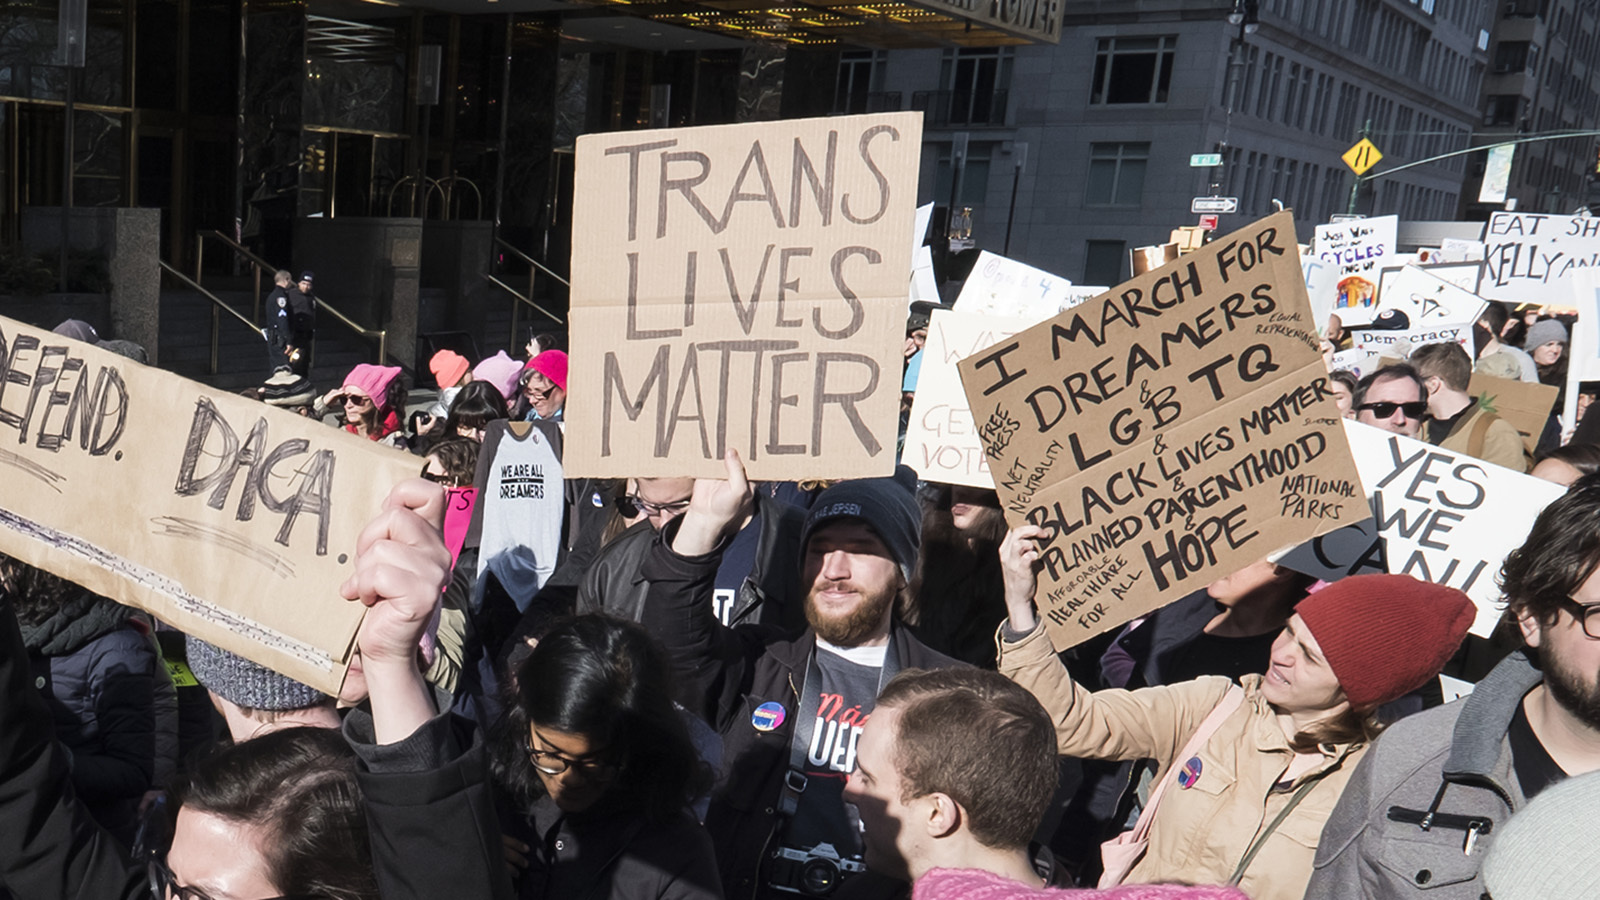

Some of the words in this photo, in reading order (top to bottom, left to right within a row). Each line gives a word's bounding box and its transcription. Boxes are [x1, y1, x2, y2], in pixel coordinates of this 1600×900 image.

[604, 124, 900, 241] TRANS
[1491, 214, 1549, 236] EAT
[1484, 242, 1600, 287] KELLYAN
[625, 244, 882, 340] LIVES
[975, 341, 1028, 397] I
[1050, 261, 1203, 361] MARCH
[1216, 227, 1285, 283] FOR
[1025, 284, 1277, 433] DREAMERS
[1362, 328, 1460, 344] Demcracy
[0, 324, 129, 461] EFEND.
[601, 340, 882, 461] MATTER
[1140, 379, 1154, 402] &
[922, 404, 976, 437] GE
[979, 402, 1008, 444] FREE
[986, 418, 1020, 460] PRESS
[1024, 462, 1157, 551] BLACK
[1157, 426, 1235, 482] LIVES
[1239, 377, 1335, 442] MATTER
[1152, 434, 1169, 456] &
[500, 485, 544, 499] DREAMERS
[501, 465, 512, 478] WE
[513, 464, 529, 478] ARE
[531, 464, 544, 478] ALL
[1001, 456, 1027, 491] NET
[1009, 440, 1064, 514] NEUTRALITY
[1172, 475, 1185, 492] &
[1280, 474, 1357, 498] NATIONAL
[1376, 435, 1488, 510] YES
[1036, 515, 1143, 583] PLANNED
[1144, 430, 1327, 532] PARENTHOOD
[1185, 515, 1196, 532] &
[1280, 492, 1344, 519] PARKS
[1372, 490, 1465, 551] WE
[1142, 504, 1260, 592] HOPE
[1047, 555, 1112, 604] AFFORDABLE
[1047, 554, 1128, 626] HEALTHCARE
[1078, 602, 1110, 629] FOR
[1111, 570, 1143, 601] ALL
